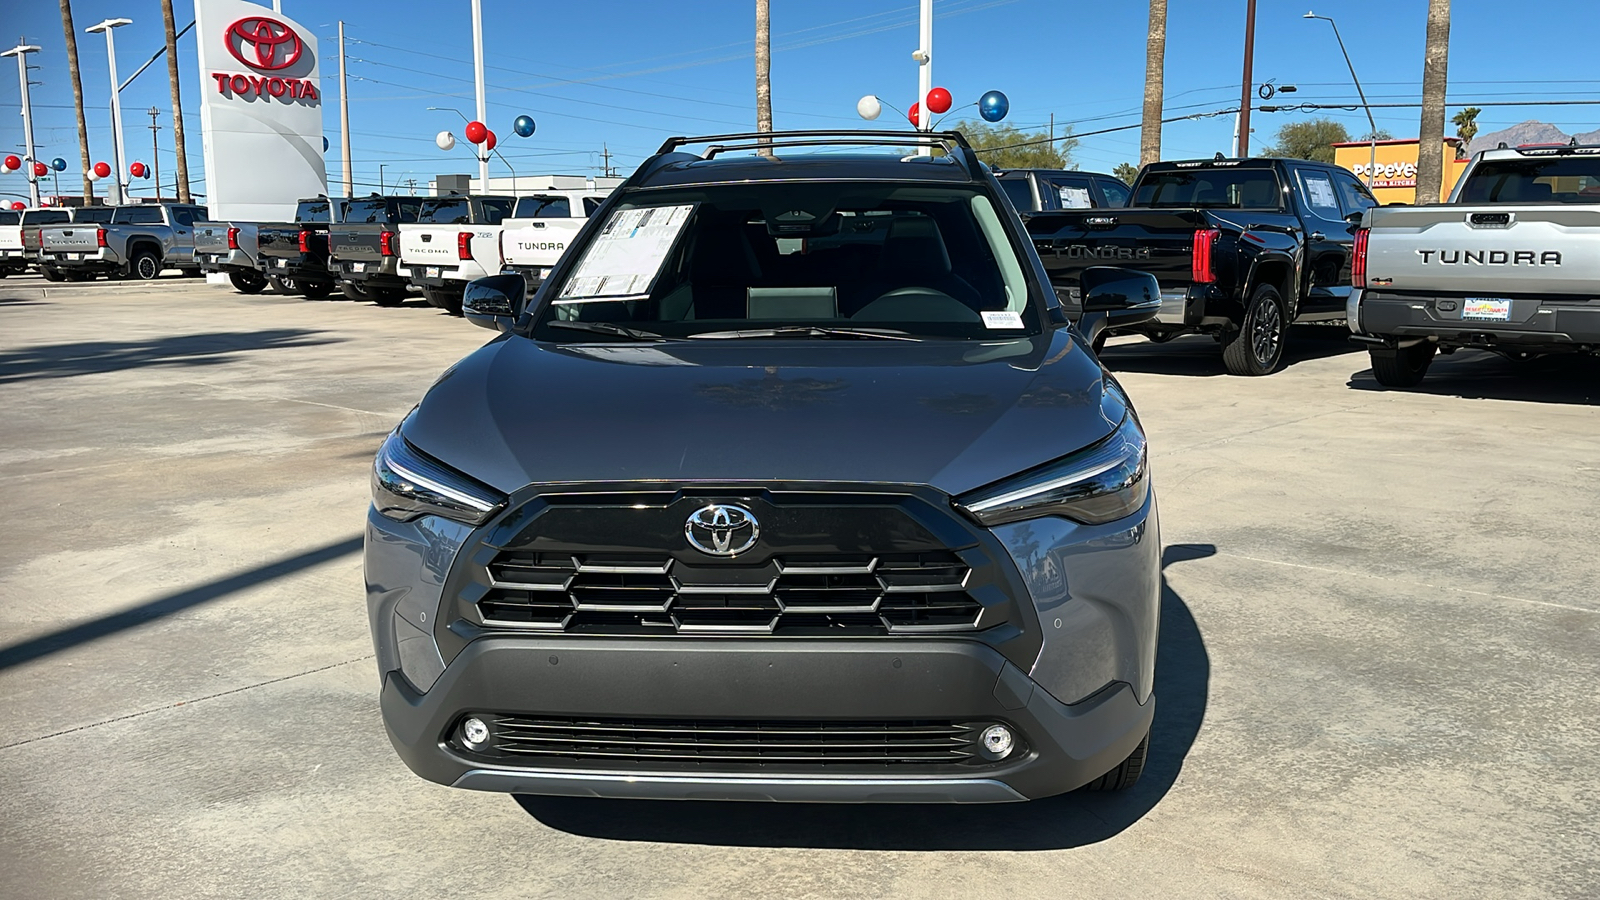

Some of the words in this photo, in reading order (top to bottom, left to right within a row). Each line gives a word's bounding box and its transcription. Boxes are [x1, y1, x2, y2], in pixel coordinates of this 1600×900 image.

[212, 73, 317, 100] TOYOTA
[518, 242, 565, 251] TUNDRA
[1052, 246, 1151, 260] TUNDRA
[1416, 249, 1563, 267] TUNDRA
